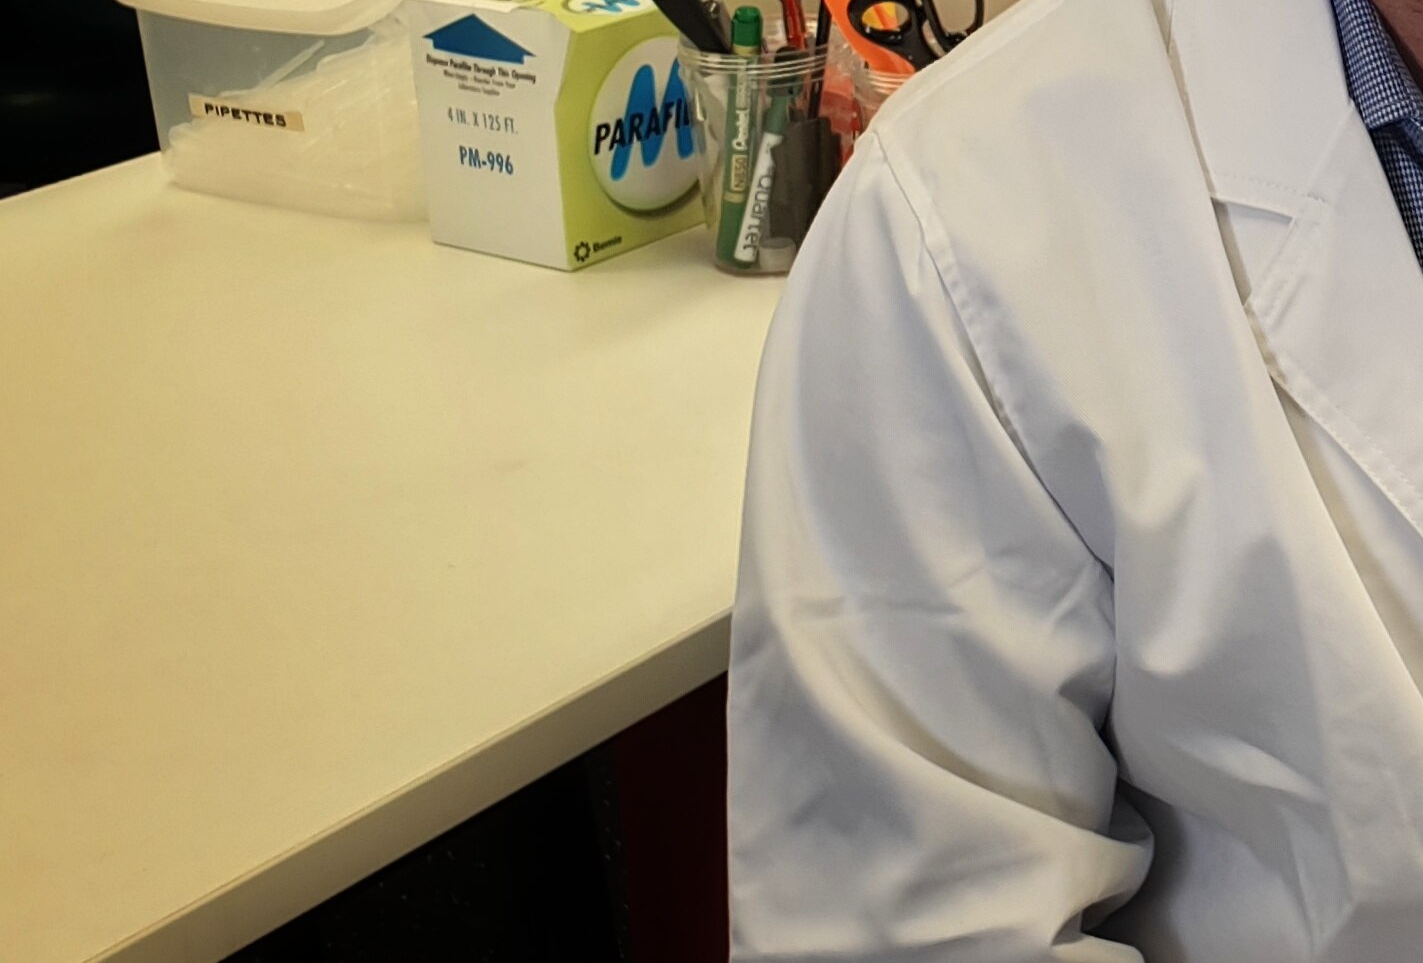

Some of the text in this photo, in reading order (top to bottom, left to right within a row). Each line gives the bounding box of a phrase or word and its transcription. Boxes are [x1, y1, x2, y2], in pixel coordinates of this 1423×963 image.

[204, 102, 287, 127] PIPETTES
[447, 107, 454, 122] 4
[472, 112, 479, 127] X
[482, 113, 501, 131] 125
[459, 145, 514, 175] PM-996
